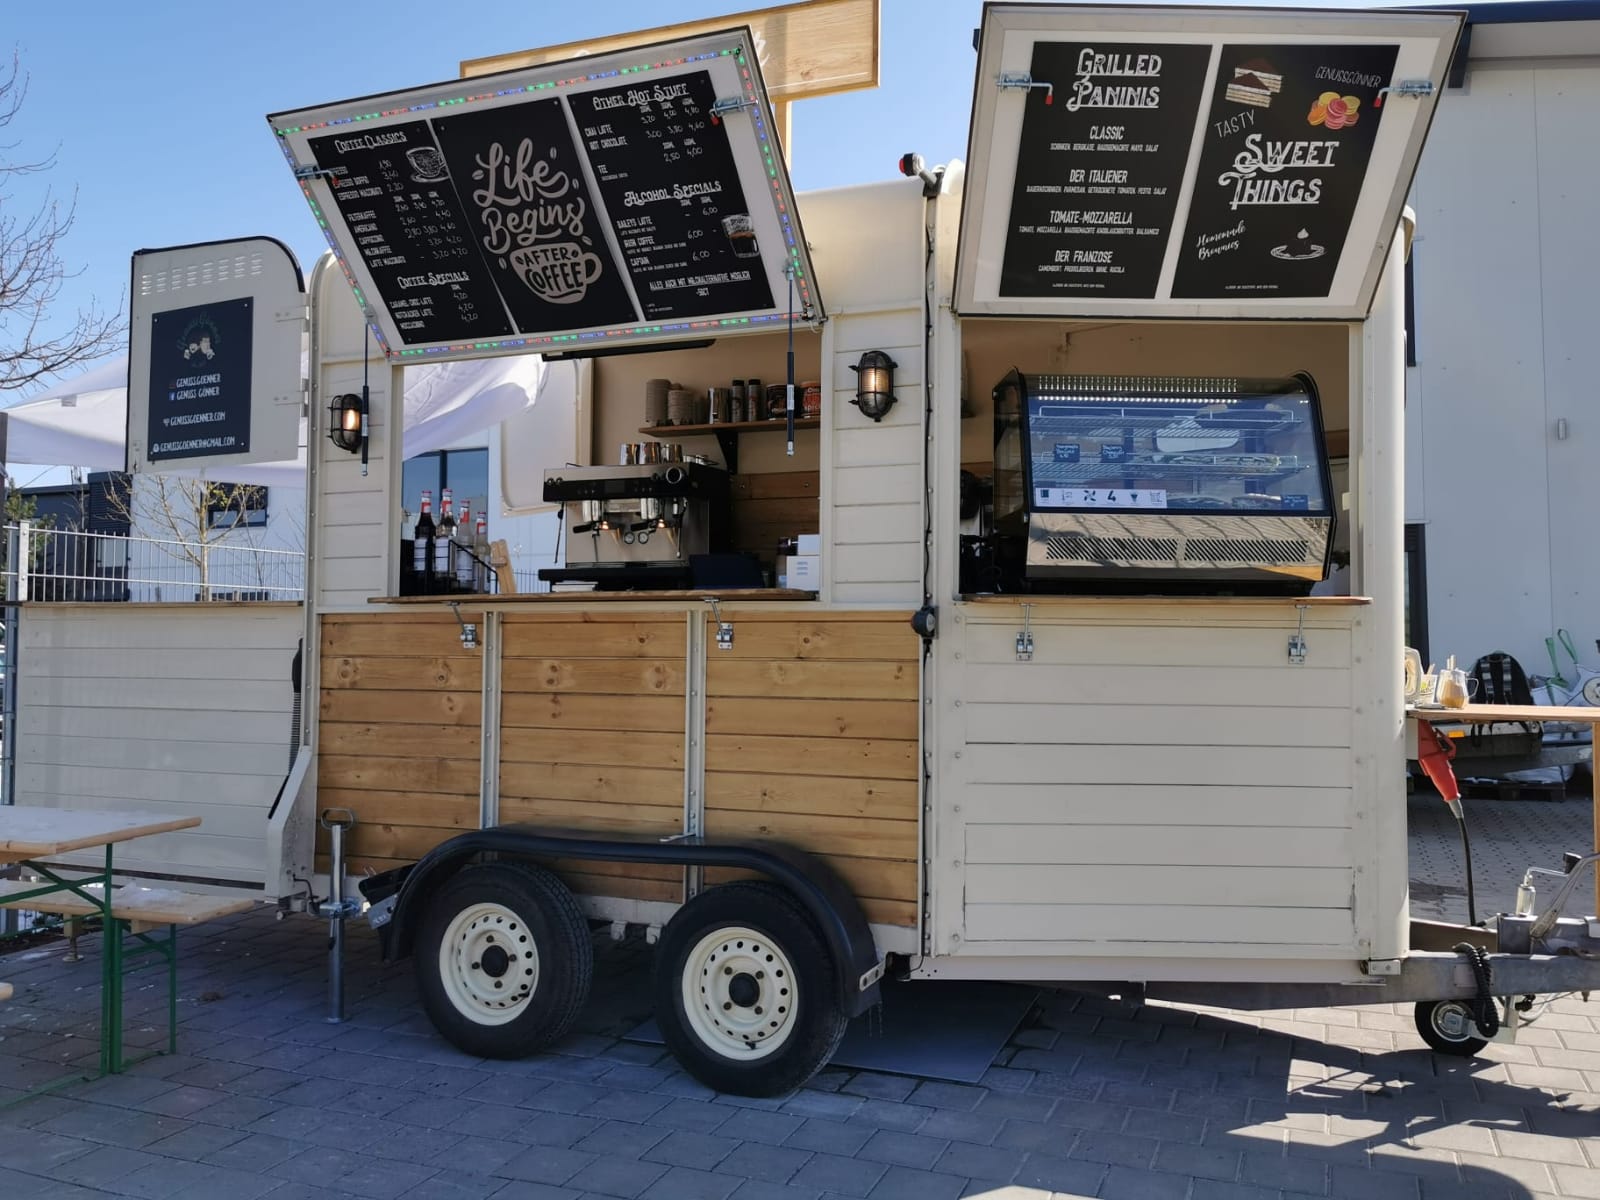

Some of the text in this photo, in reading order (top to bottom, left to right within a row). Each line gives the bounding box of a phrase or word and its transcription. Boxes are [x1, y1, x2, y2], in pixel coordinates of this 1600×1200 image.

[1075, 48, 1162, 80] GRILLED
[592, 83, 690, 111] OTHER HOT STUFF
[1066, 81, 1160, 112] PANINIS
[1089, 125, 1125, 140] CLASSIC
[1214, 109, 1256, 138] TASTY
[334, 131, 408, 154] COFFEE CLASSICS
[1232, 133, 1340, 173] SWEET
[473, 137, 569, 207] Life
[1069, 169, 1128, 183] DER ITALIENER
[624, 188, 671, 207] ALCOHOL
[673, 180, 722, 199] SPECIALS
[1218, 172, 1323, 210] THINGS
[702, 207, 718, 216] 6,00
[1050, 210, 1133, 224] TOMATE-MOZZARELLA
[481, 197, 585, 254] Begins
[687, 229, 703, 239] 6,00
[1196, 219, 1246, 247] Homemade
[523, 247, 571, 267] AFTER
[1055, 250, 1113, 263] DER FRANZOSE
[397, 271, 470, 290] COFFEE SPECIALS
[524, 262, 584, 294] COFFEE
[176, 389, 197, 401] GENUSS
